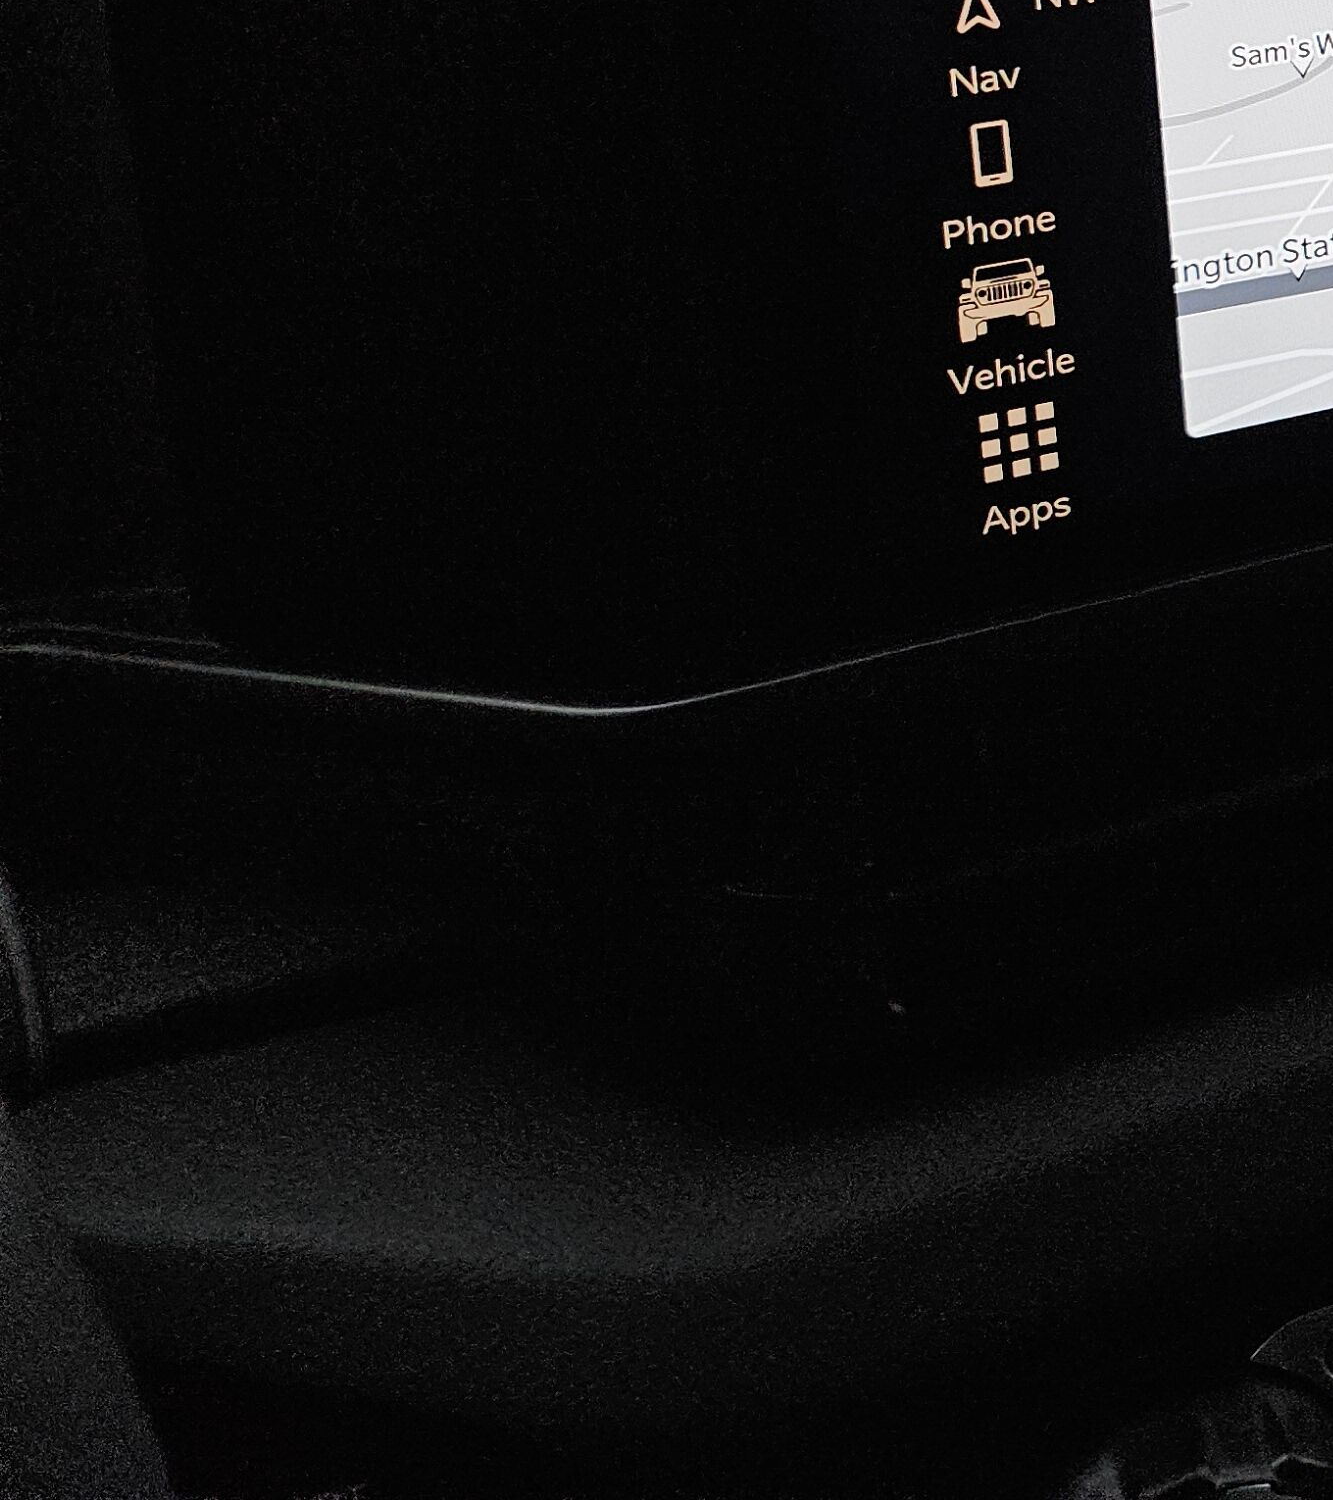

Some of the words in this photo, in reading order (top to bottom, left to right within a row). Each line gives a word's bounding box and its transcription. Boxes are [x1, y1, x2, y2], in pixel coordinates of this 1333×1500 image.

[1231, 38, 1311, 67] Sam's
[949, 66, 1020, 97] Nav
[943, 209, 1056, 249] Phone
[947, 349, 1075, 395] Vehicle
[982, 497, 1072, 536] Apps
